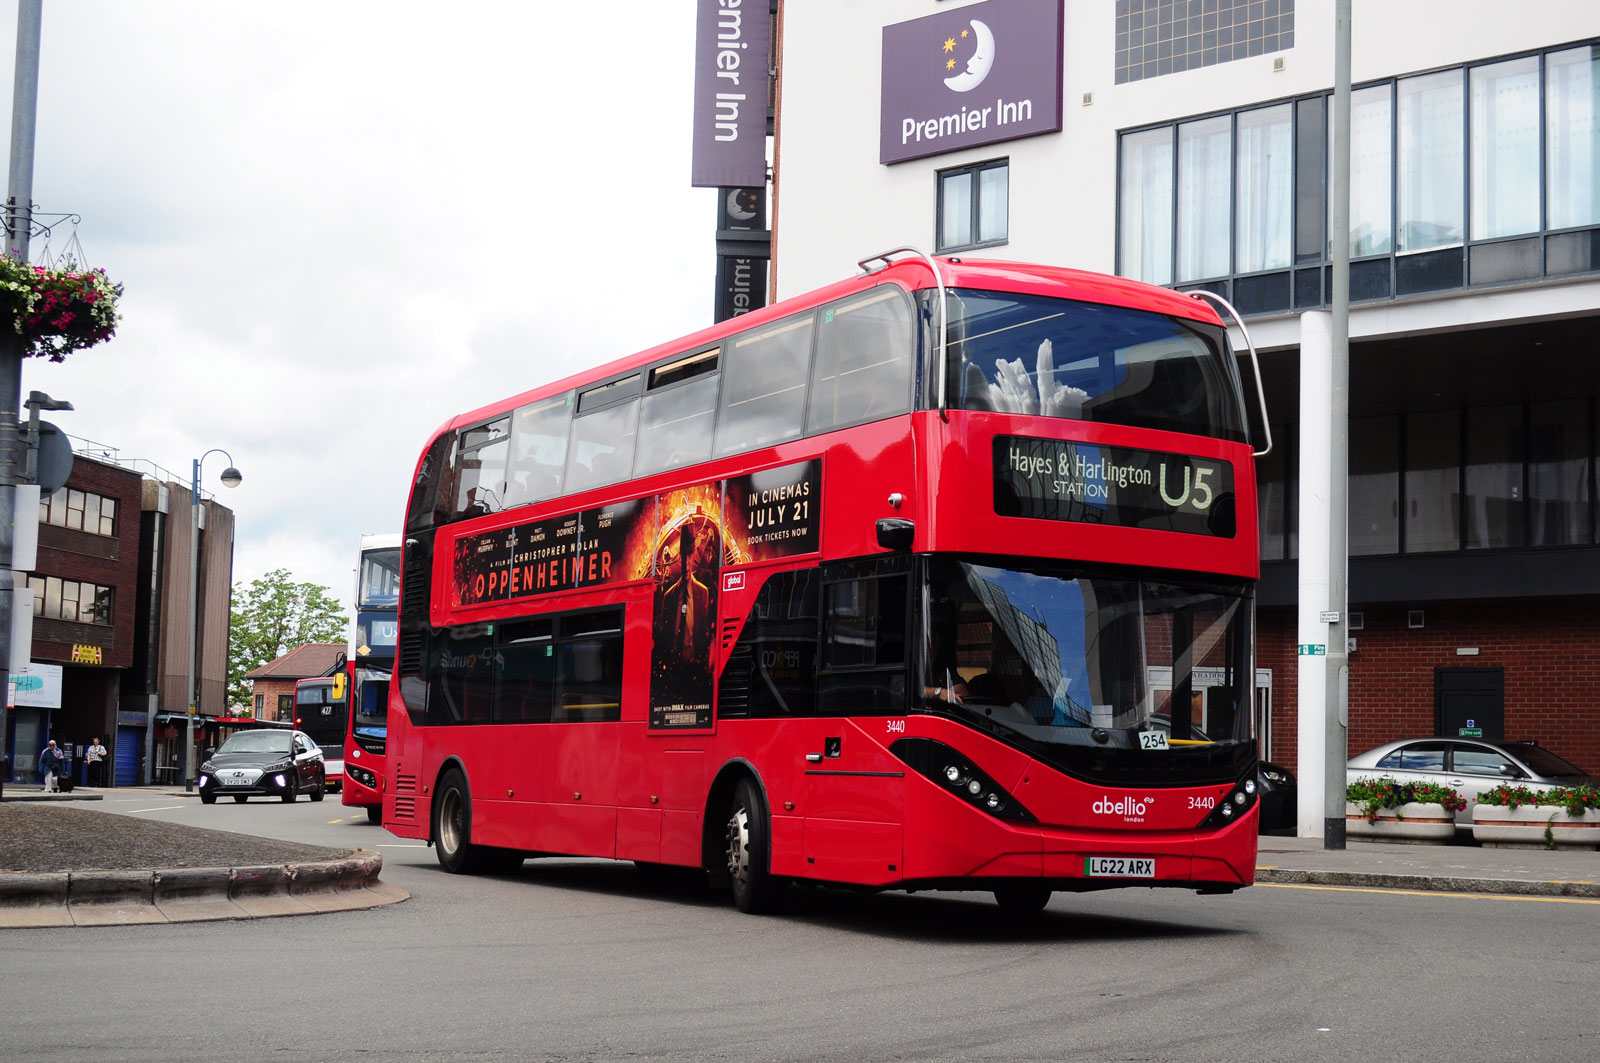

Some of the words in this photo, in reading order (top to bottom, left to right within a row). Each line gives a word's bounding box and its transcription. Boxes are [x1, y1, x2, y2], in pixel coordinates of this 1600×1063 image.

[715, 93, 746, 142] Inn
[902, 106, 992, 144] Premier
[997, 98, 1032, 126] Inn
[1009, 447, 1052, 479] Hayes
[1058, 452, 1070, 476] &
[1075, 454, 1151, 488] Harlington
[1159, 463, 1214, 510] U5
[748, 492, 758, 507] IN
[762, 481, 810, 504] CINEMAS
[1053, 480, 1109, 498] STATION
[748, 504, 786, 530] JULY
[793, 500, 809, 521] 21
[747, 536, 763, 545] BOOK
[765, 529, 790, 542] TICKETS
[791, 527, 808, 537] NOW
[514, 544, 566, 563] CHRISTOPHER
[570, 538, 599, 553] NOLAN
[475, 551, 612, 598] OPPENHEIMER
[727, 574, 741, 588] global
[321, 706, 332, 715] 427
[886, 720, 905, 733] 3440
[1142, 733, 1166, 749] 254
[1092, 795, 1146, 815] abellio
[1187, 796, 1215, 809] 3440
[1092, 859, 1125, 874] LG22
[1128, 860, 1152, 875] ARX
